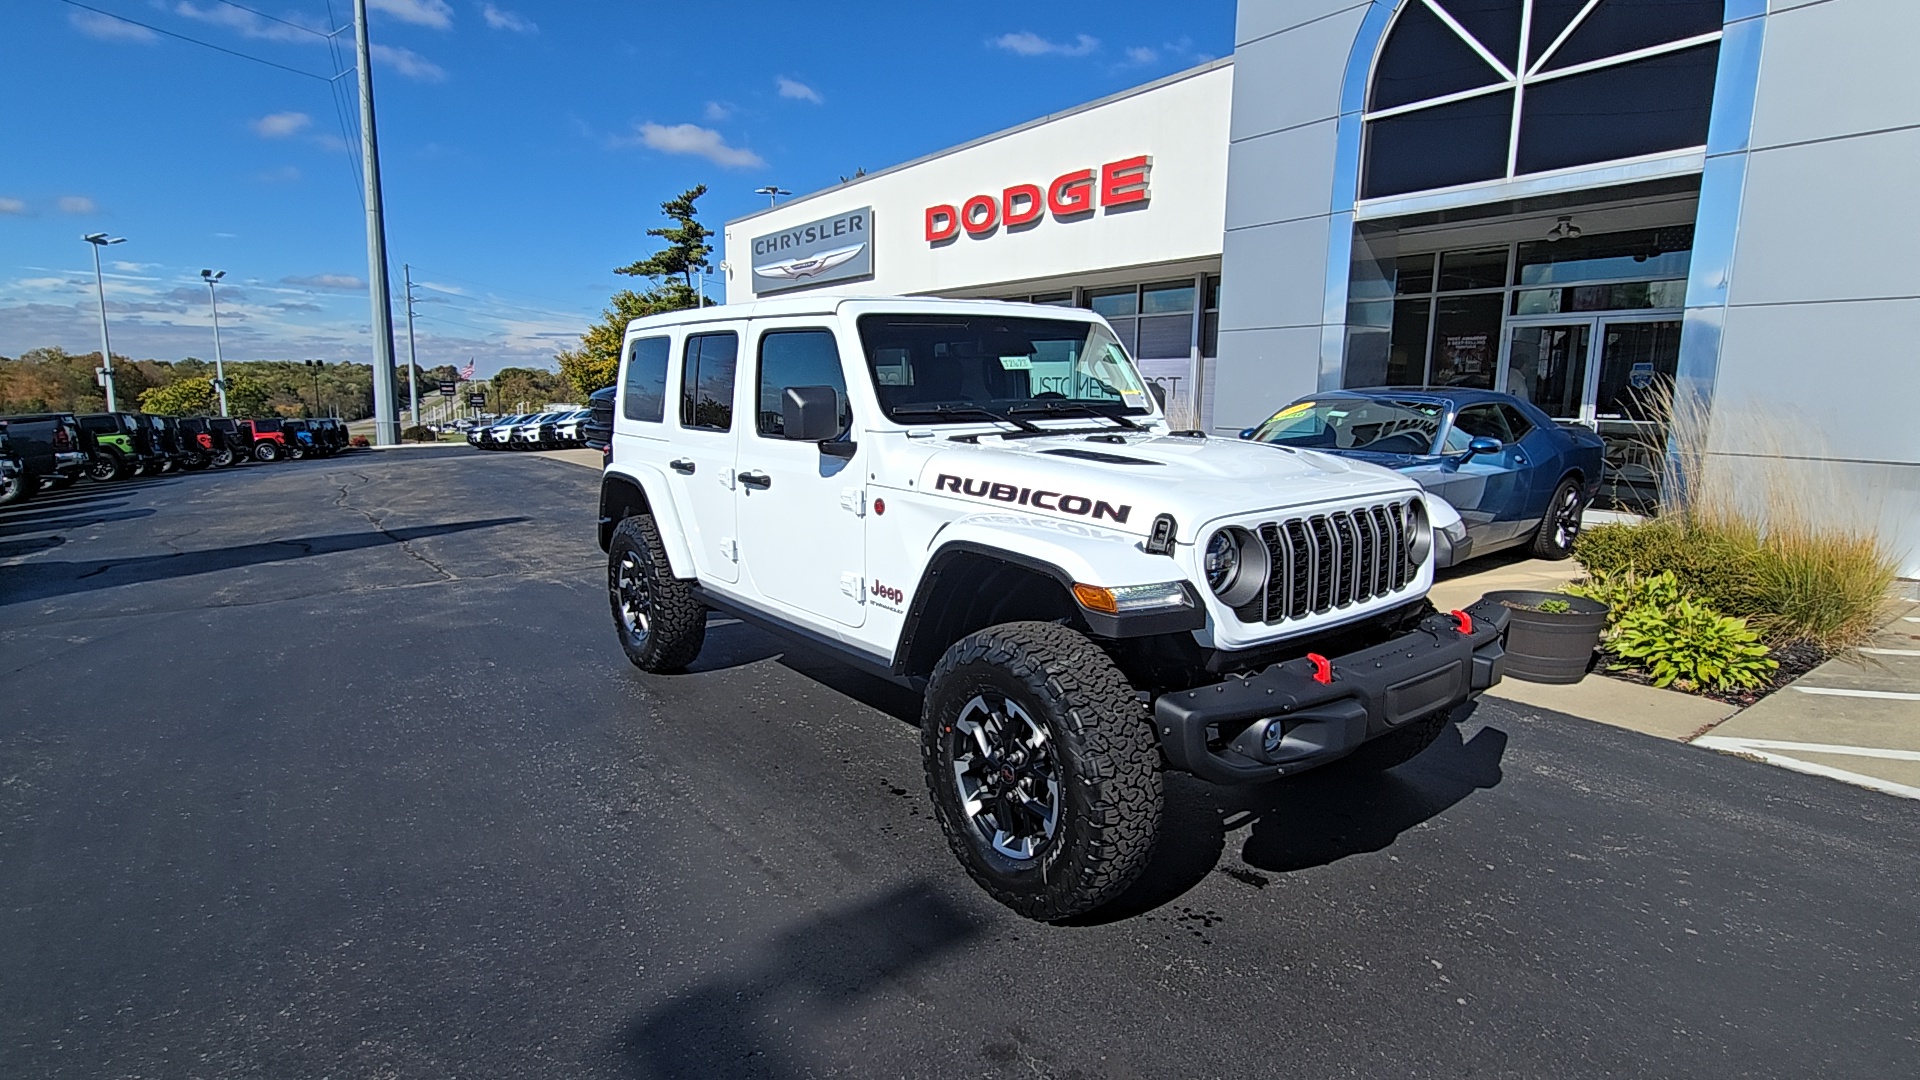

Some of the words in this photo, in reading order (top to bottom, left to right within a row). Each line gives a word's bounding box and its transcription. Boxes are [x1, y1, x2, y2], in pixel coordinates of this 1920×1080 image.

[926, 155, 1152, 242] DODGE
[755, 215, 863, 255] CHRYSLER
[935, 473, 1132, 524] RUBICON
[870, 578, 904, 606] Jeep
